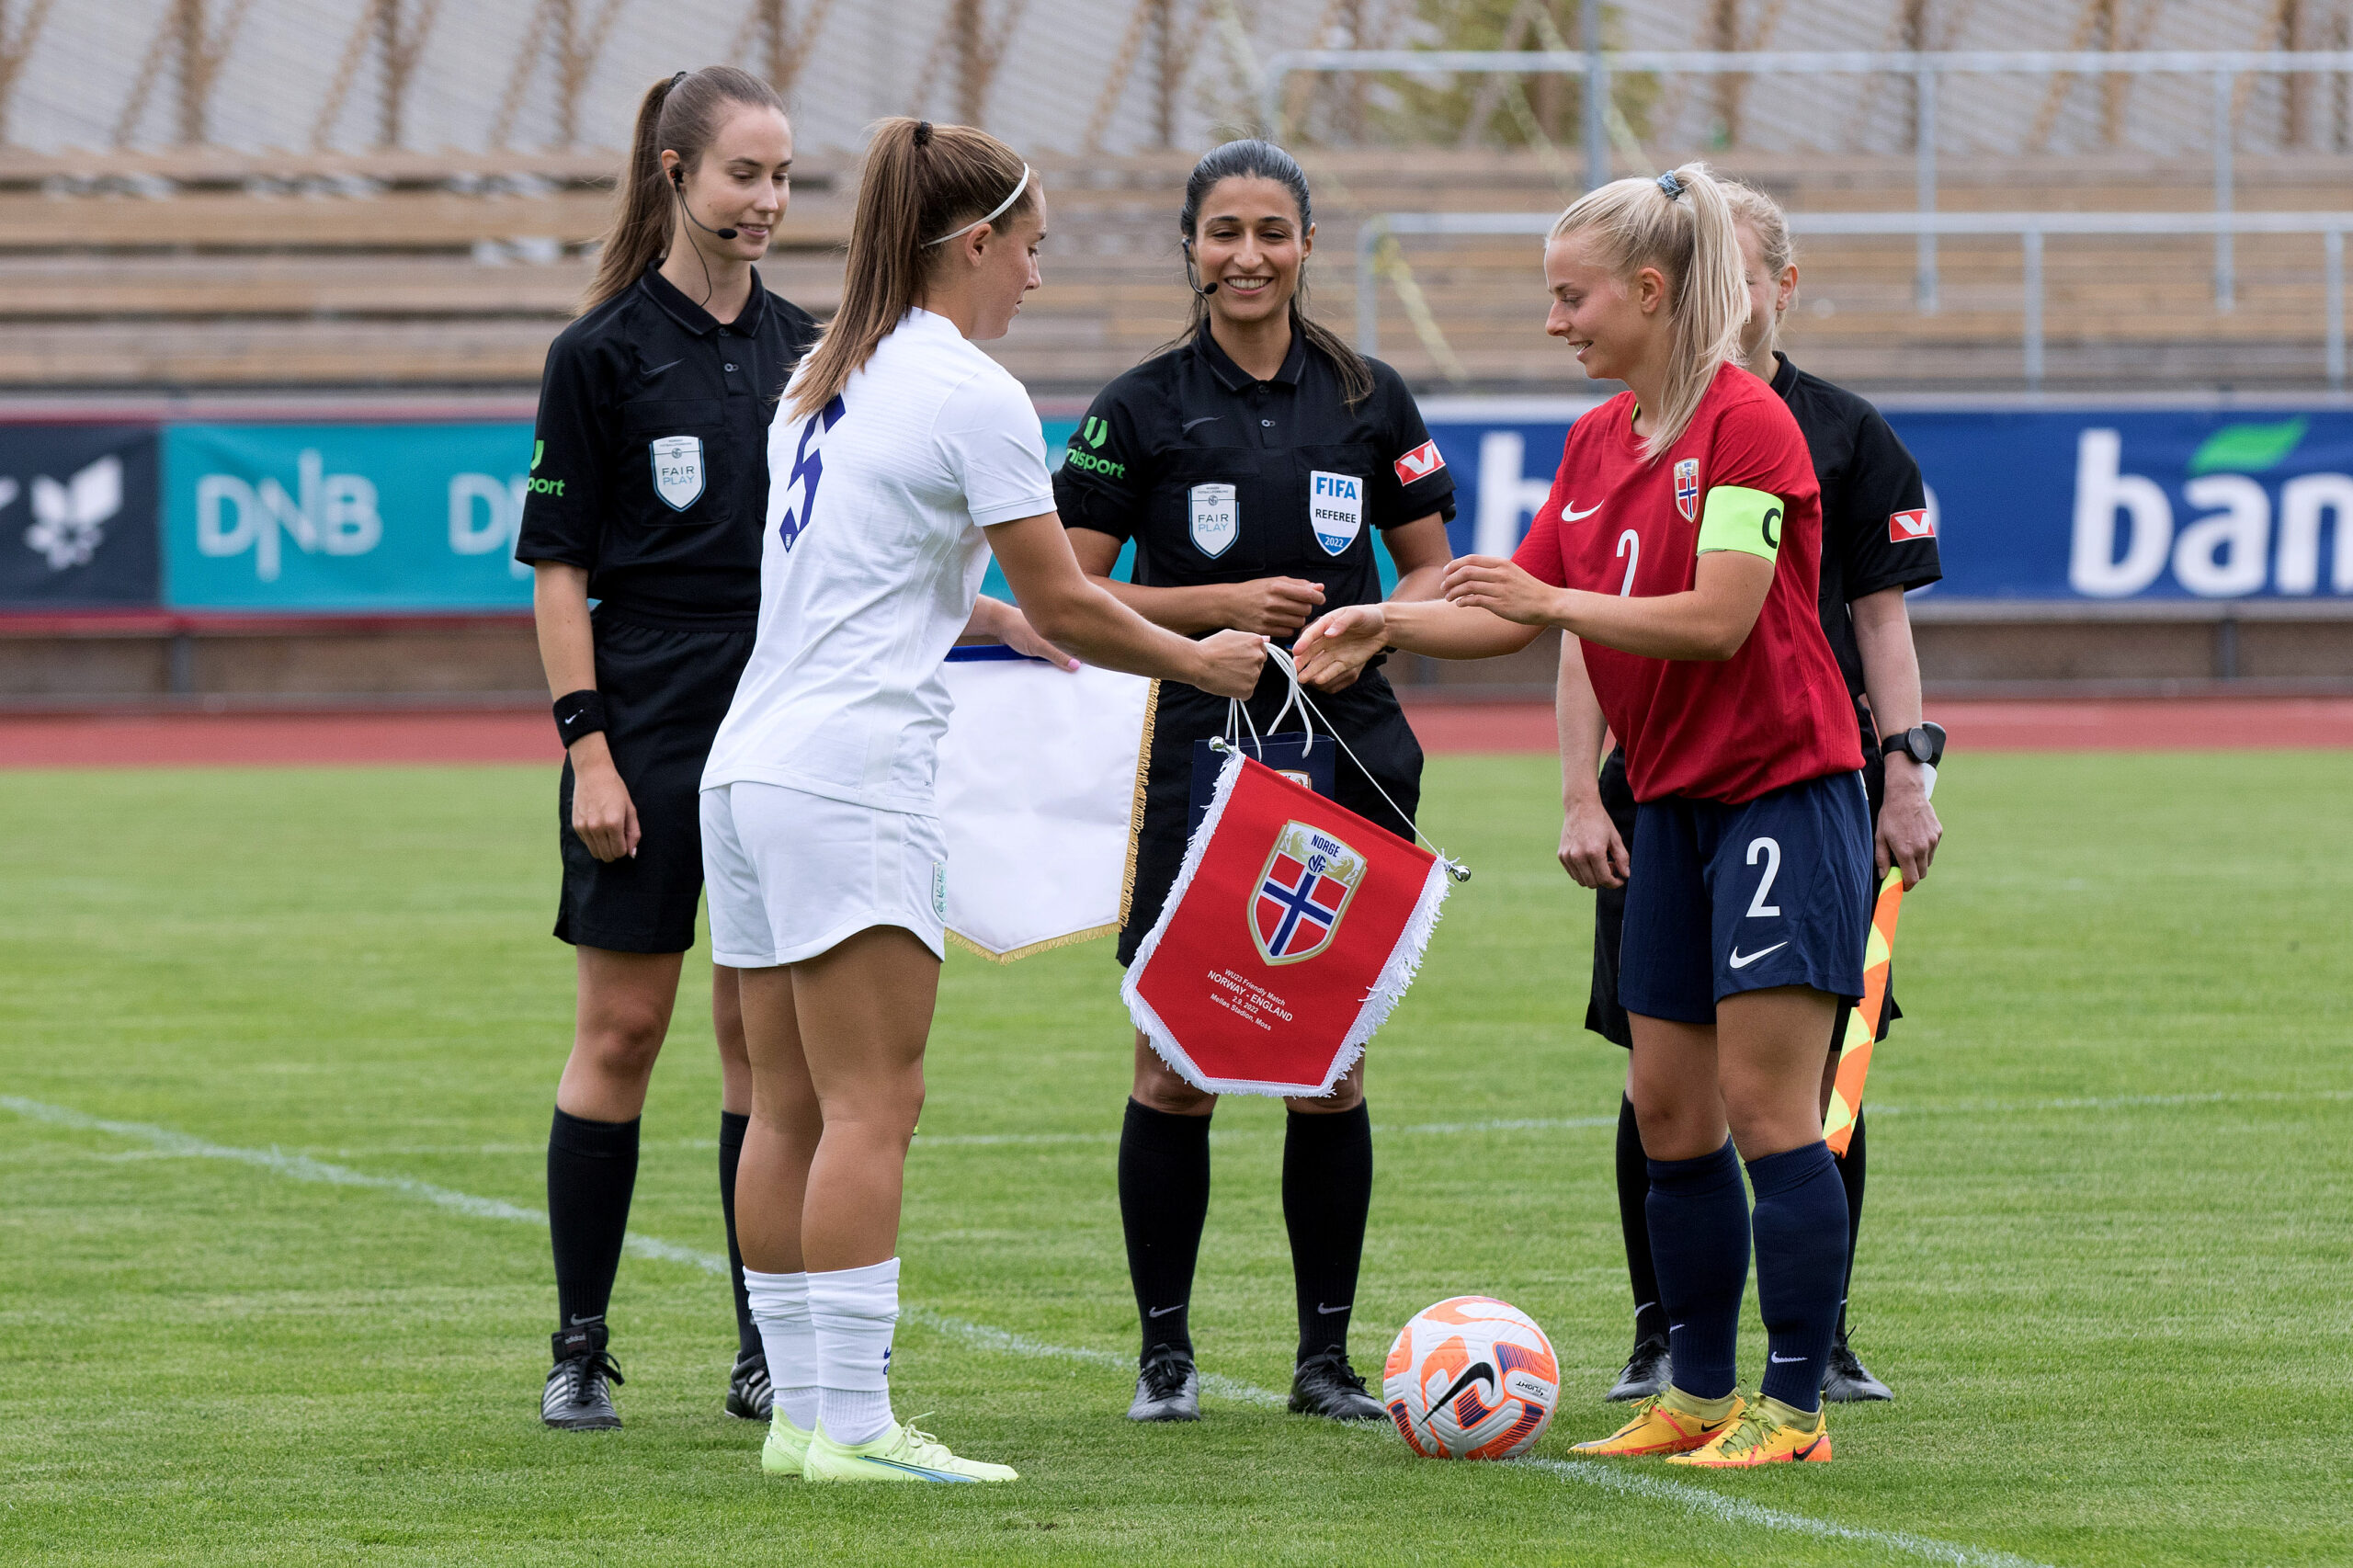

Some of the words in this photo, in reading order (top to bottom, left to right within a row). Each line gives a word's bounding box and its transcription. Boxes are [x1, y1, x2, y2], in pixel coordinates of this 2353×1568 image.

[662, 465, 695, 476] FAIR
[1067, 445, 1125, 479] nisport
[663, 475, 695, 485] PLAY
[1316, 476, 1357, 500] FIFA
[195, 448, 382, 582] DNB
[1198, 514, 1229, 523] FAIR
[1315, 508, 1357, 524] REFEREE
[1198, 523, 1229, 532] PLAY
[1762, 507, 1781, 549] C
[1324, 536, 1344, 548] 2022
[1616, 529, 1640, 597] 2
[1311, 835, 1340, 858] NORGE
[1745, 836, 1781, 917] 2
[1207, 970, 1246, 995] NORWAY
[1250, 994, 1293, 1022] ENGLAND
[1224, 968, 1244, 983] WU23
[1242, 978, 1267, 996] Friendly
[1267, 992, 1286, 1006] Match
[1243, 1002, 1259, 1014] 2022
[1255, 1017, 1272, 1031] Moss
